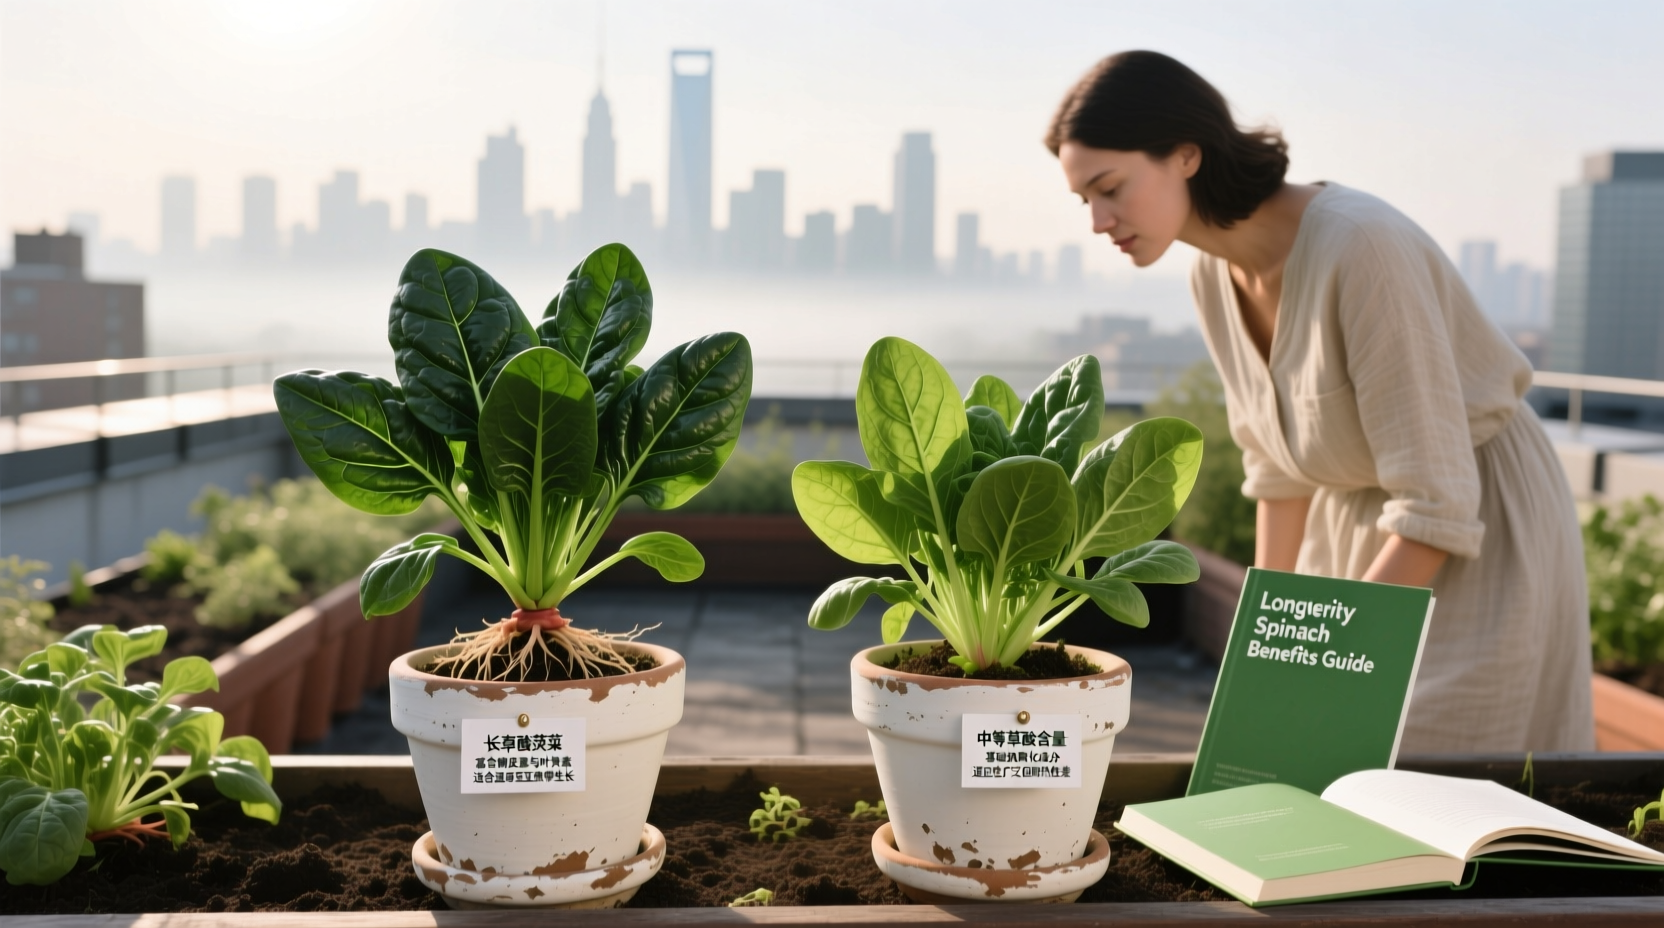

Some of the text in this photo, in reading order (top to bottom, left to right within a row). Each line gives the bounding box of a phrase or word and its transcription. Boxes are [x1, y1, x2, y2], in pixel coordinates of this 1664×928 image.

[1254, 615, 1330, 643] Spinach
[1247, 640, 1375, 674] Benefits Guide
